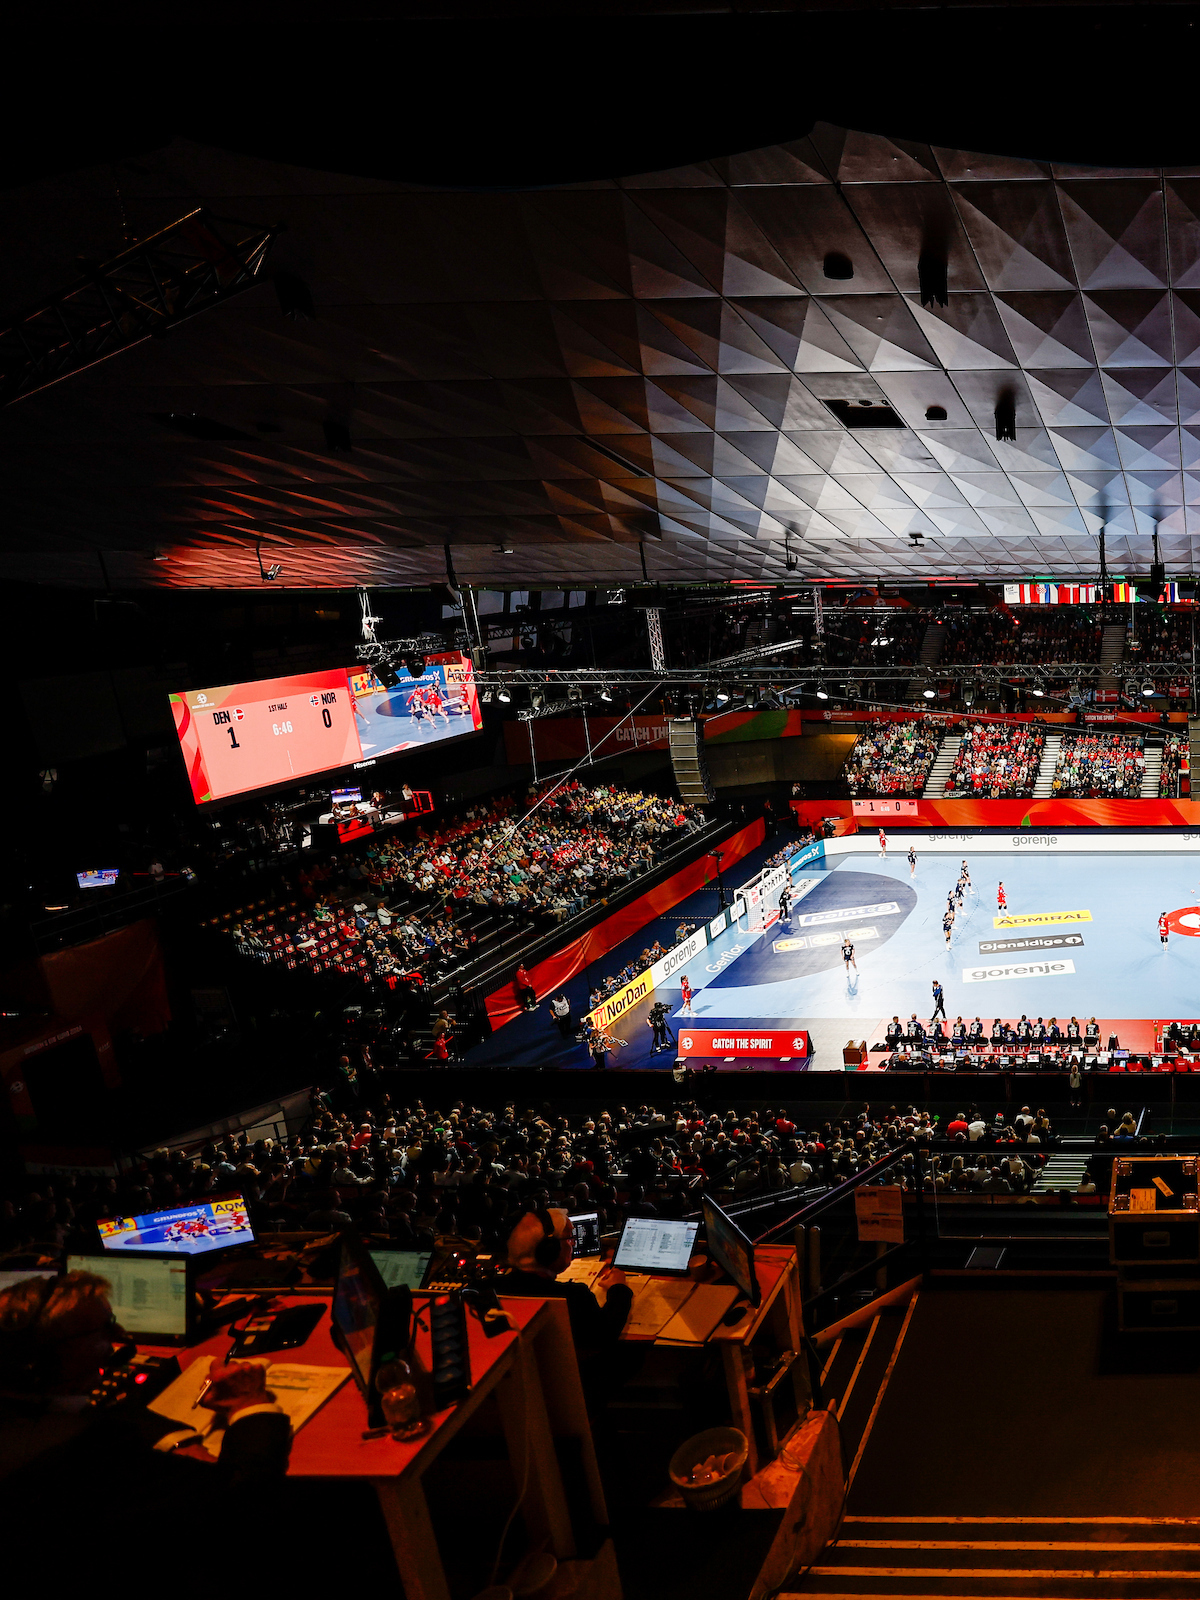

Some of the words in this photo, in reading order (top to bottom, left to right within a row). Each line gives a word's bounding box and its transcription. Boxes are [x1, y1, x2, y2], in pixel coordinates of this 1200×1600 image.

[321, 692, 337, 705] NOR
[277, 703, 288, 711] HALF
[213, 710, 231, 725] DEN
[322, 708, 332, 728] 0
[272, 721, 293, 736] 6:46
[616, 727, 650, 741] CATCH
[227, 726, 240, 749] 1
[353, 757, 376, 770] Hisense
[1012, 834, 1058, 847] gorenje
[997, 914, 1089, 925] ADMIRAL
[980, 938, 1063, 951] Gjensidige
[663, 939, 697, 976] gorenje
[705, 944, 745, 973] Gerflor
[971, 963, 1066, 980] gorenje
[606, 981, 647, 1021] NorDan
[712, 1038, 735, 1049] CATCH
[736, 1038, 749, 1049] THE
[750, 1038, 773, 1049] SPIRIT
[153, 1212, 197, 1223] GRUNDFOS
